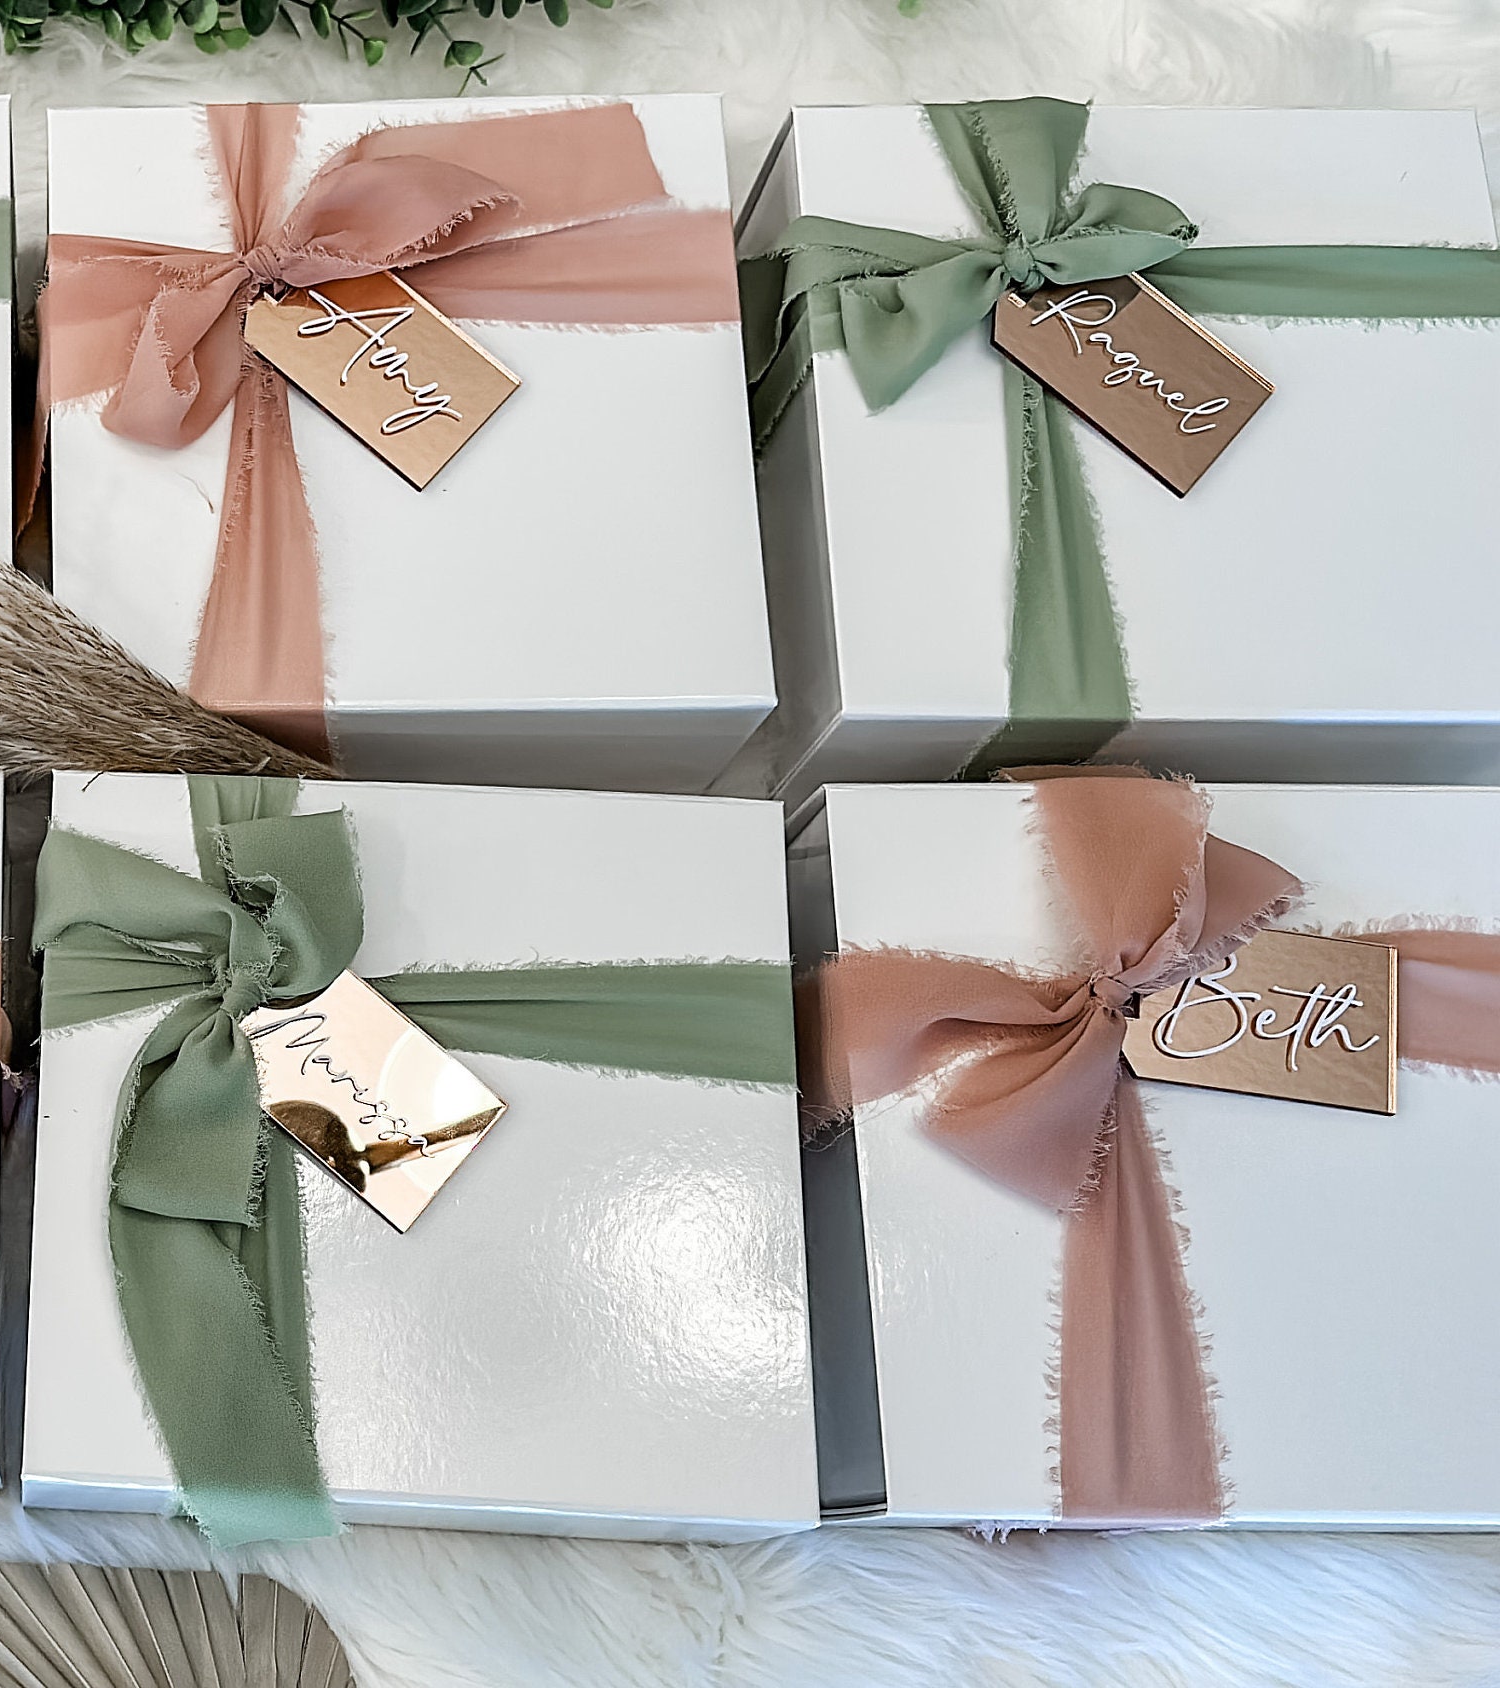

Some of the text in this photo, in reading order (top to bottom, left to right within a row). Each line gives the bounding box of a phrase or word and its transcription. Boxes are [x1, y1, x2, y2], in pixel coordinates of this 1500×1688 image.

[298, 290, 463, 434] Amy
[1030, 290, 1230, 434] Raquel
[250, 1008, 435, 1158] Marissa
[1152, 952, 1380, 1072] Beth
